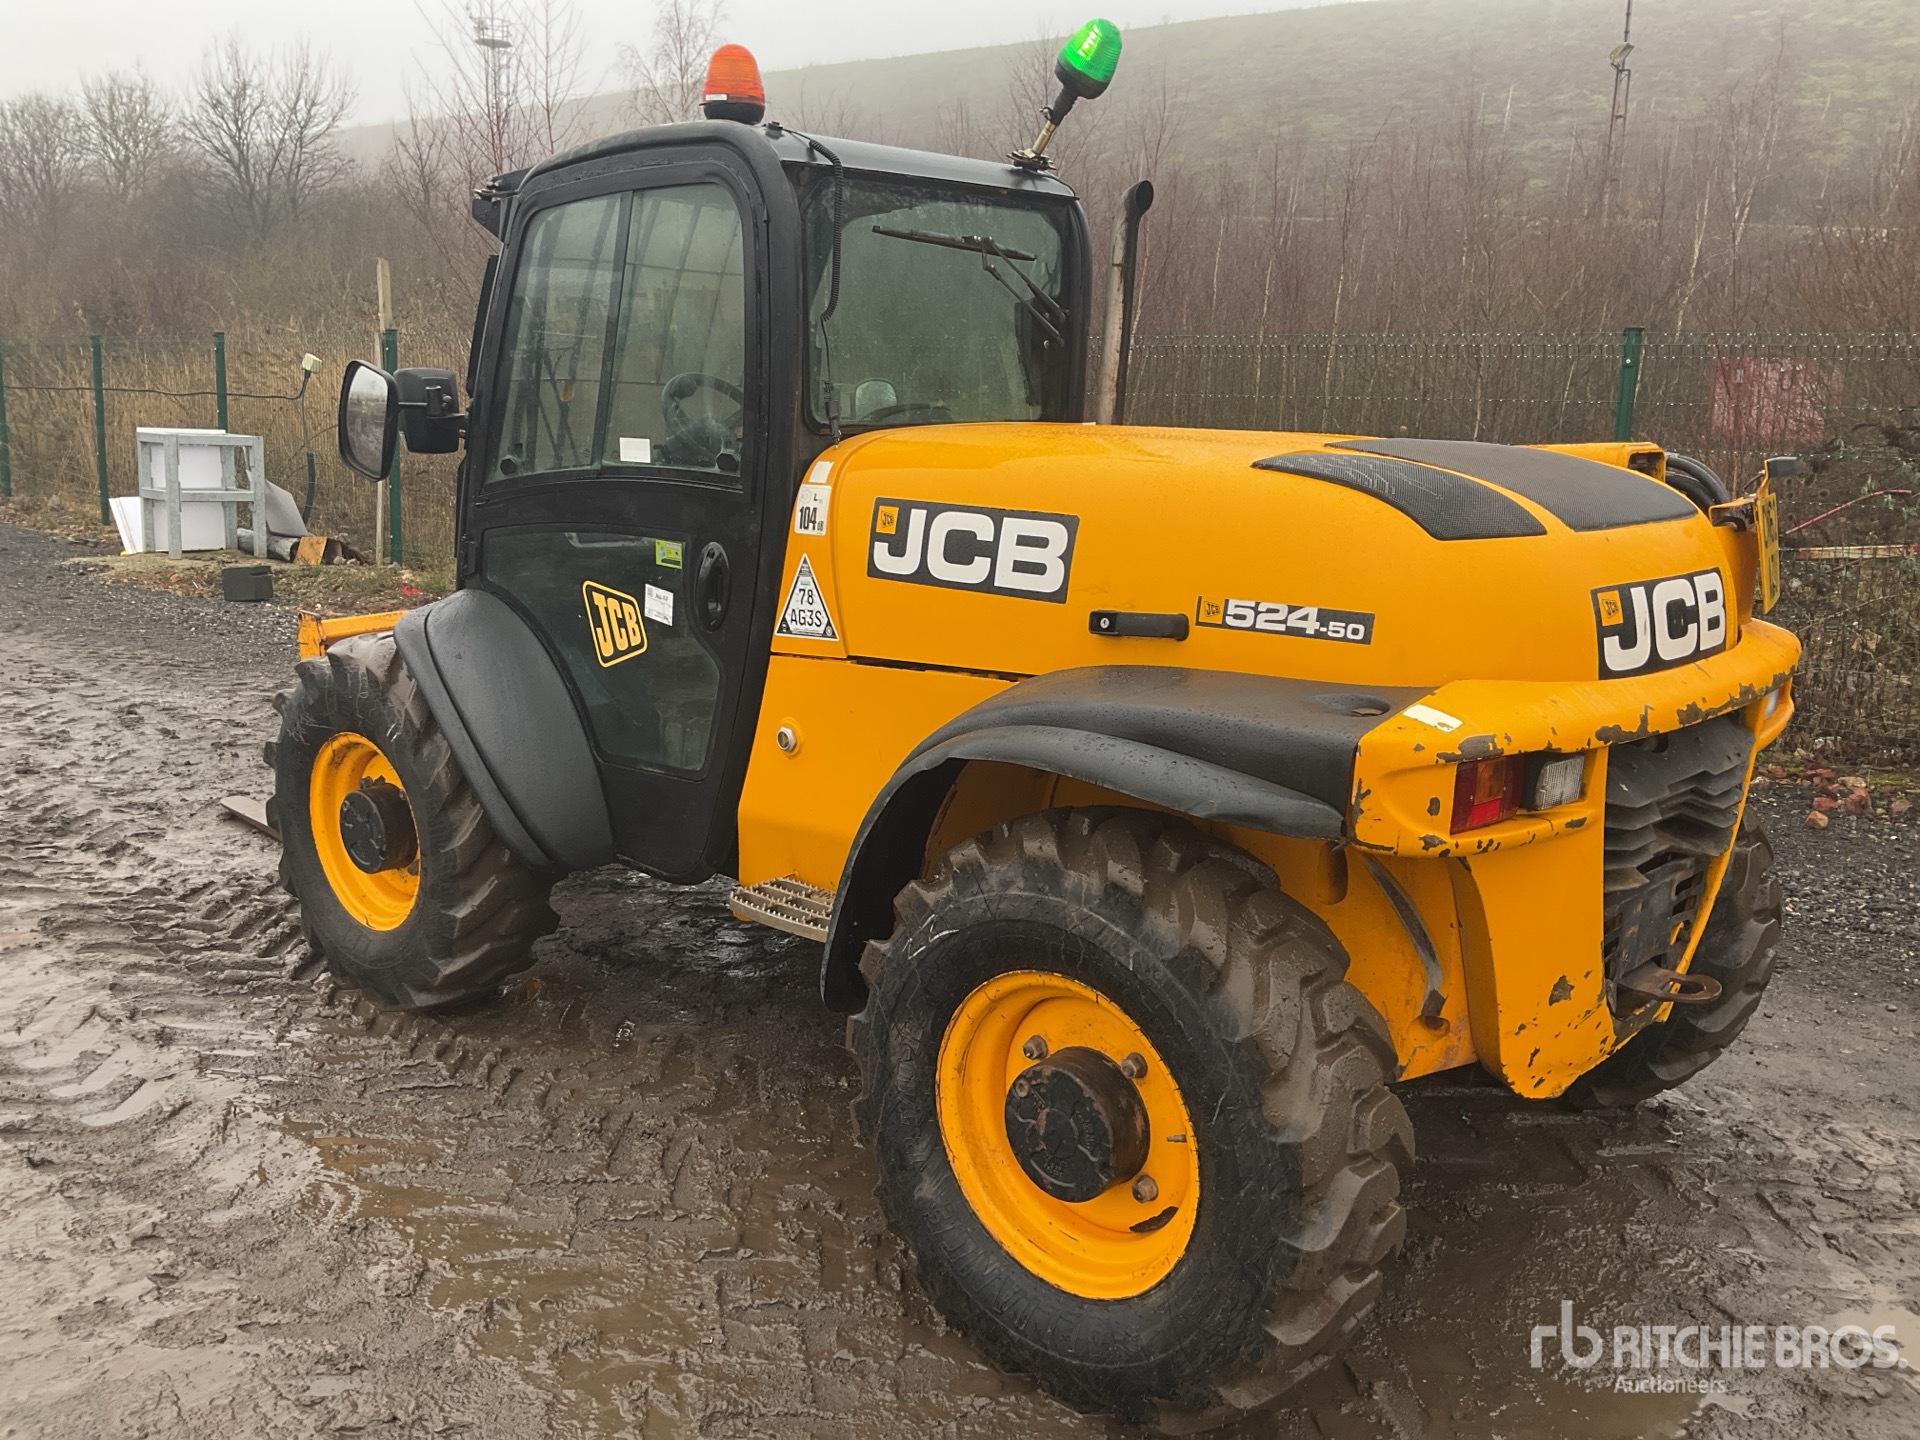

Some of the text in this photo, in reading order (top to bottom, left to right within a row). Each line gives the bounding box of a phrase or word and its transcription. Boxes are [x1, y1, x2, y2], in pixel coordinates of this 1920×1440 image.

[799, 505, 817, 531] 104
[873, 508, 1069, 593] JCB
[799, 588, 814, 606] 78
[1206, 602, 1220, 616] JCB
[592, 590, 641, 657] JCB
[790, 608, 822, 627] AG3S
[1225, 598, 1365, 640] 524-50
[1603, 571, 1726, 672] JCB
